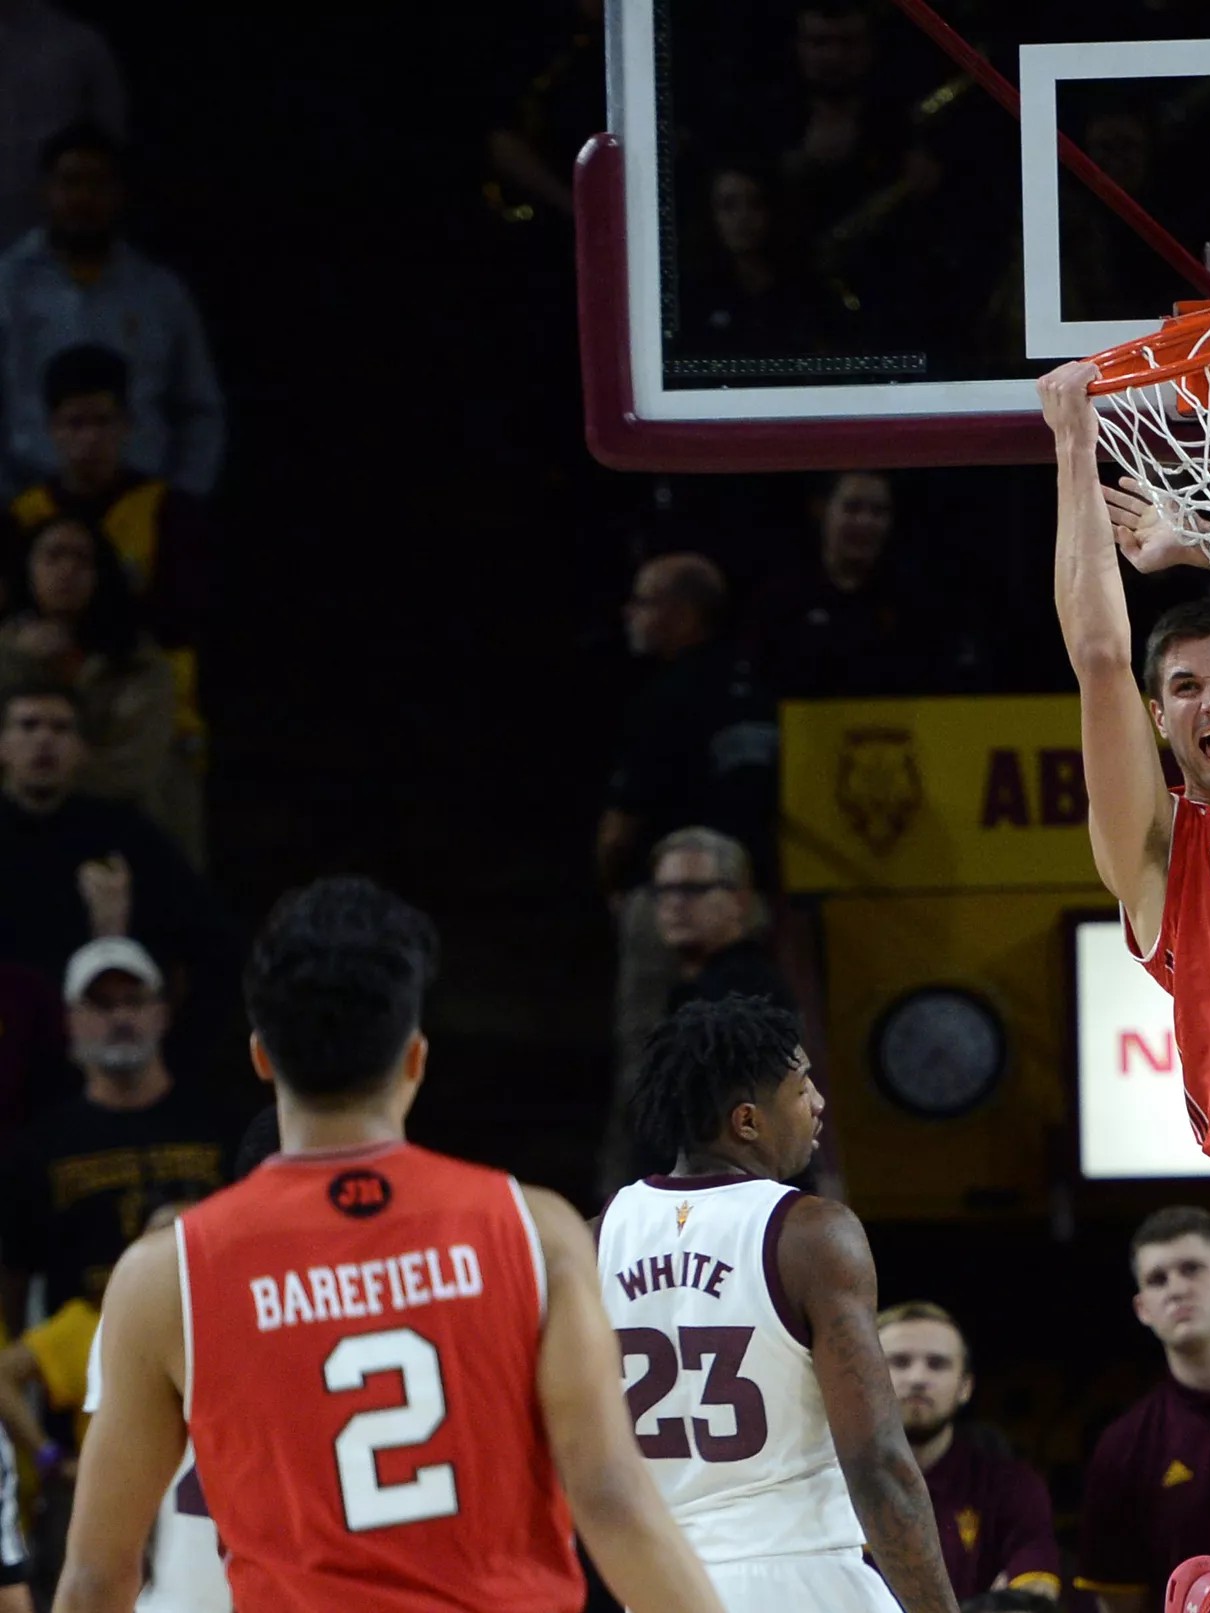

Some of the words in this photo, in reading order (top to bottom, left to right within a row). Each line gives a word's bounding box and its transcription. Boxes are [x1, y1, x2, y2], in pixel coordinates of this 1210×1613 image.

[250, 1244, 485, 1332] BAREFIELD
[615, 1250, 735, 1302] WHITE
[323, 1327, 460, 1533] 2
[613, 1325, 768, 1464] 23
